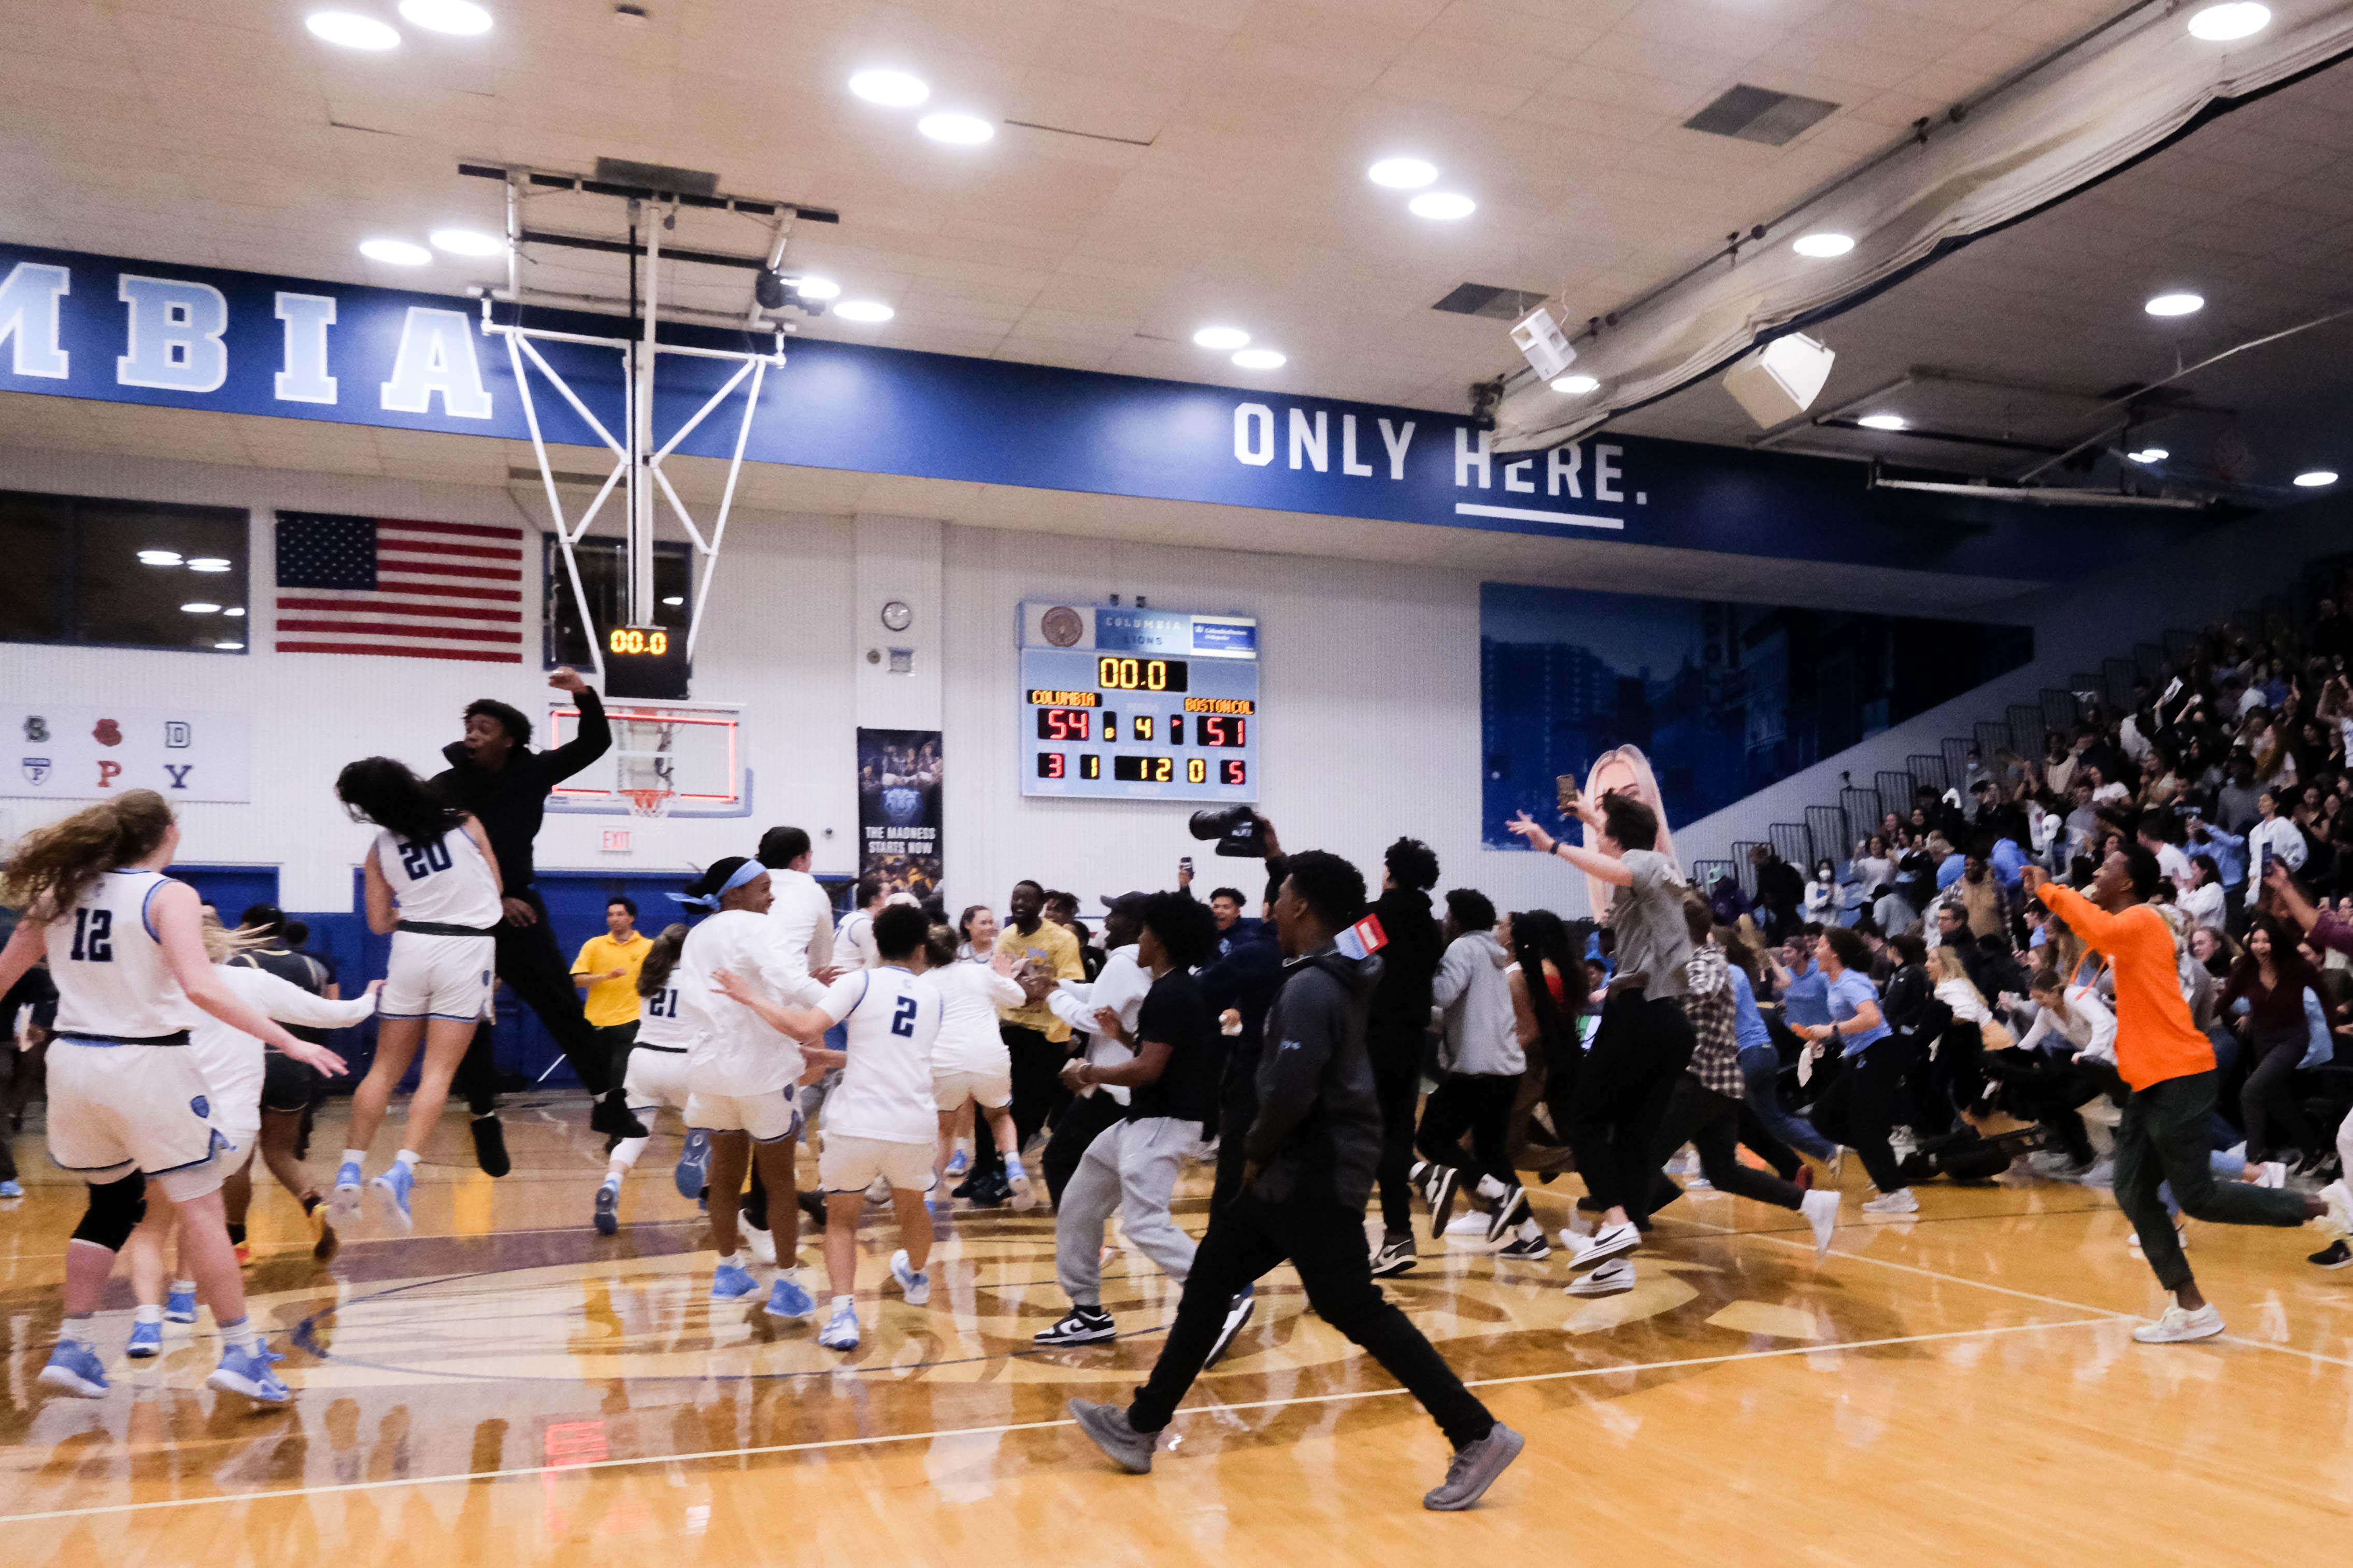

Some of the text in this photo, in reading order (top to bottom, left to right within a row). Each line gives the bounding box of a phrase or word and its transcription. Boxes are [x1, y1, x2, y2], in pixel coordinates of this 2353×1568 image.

[1234, 402, 1416, 480] ONLY
[1106, 617, 1181, 630] COLUMBIA
[610, 629, 667, 655] 00.0
[1100, 657, 1166, 691] 00.0
[1032, 689, 1096, 707] COLUMBIA
[164, 721, 191, 749] D
[1048, 709, 1088, 740] 54
[1135, 717, 1152, 739] 4
[1206, 716, 1244, 746] 51
[97, 760, 122, 787] P
[163, 764, 193, 789] Y
[1048, 753, 1063, 778] 3
[1090, 756, 1099, 778] 1
[1188, 759, 1205, 783] 0
[1228, 760, 1244, 784] 5
[603, 830, 631, 850] EXIT
[865, 826, 936, 840] THE MADNESS
[397, 835, 453, 881] 20
[868, 841, 933, 854] STARTS NOW
[70, 908, 113, 962] 12
[649, 988, 678, 1018] 21
[891, 994, 917, 1038] 2
